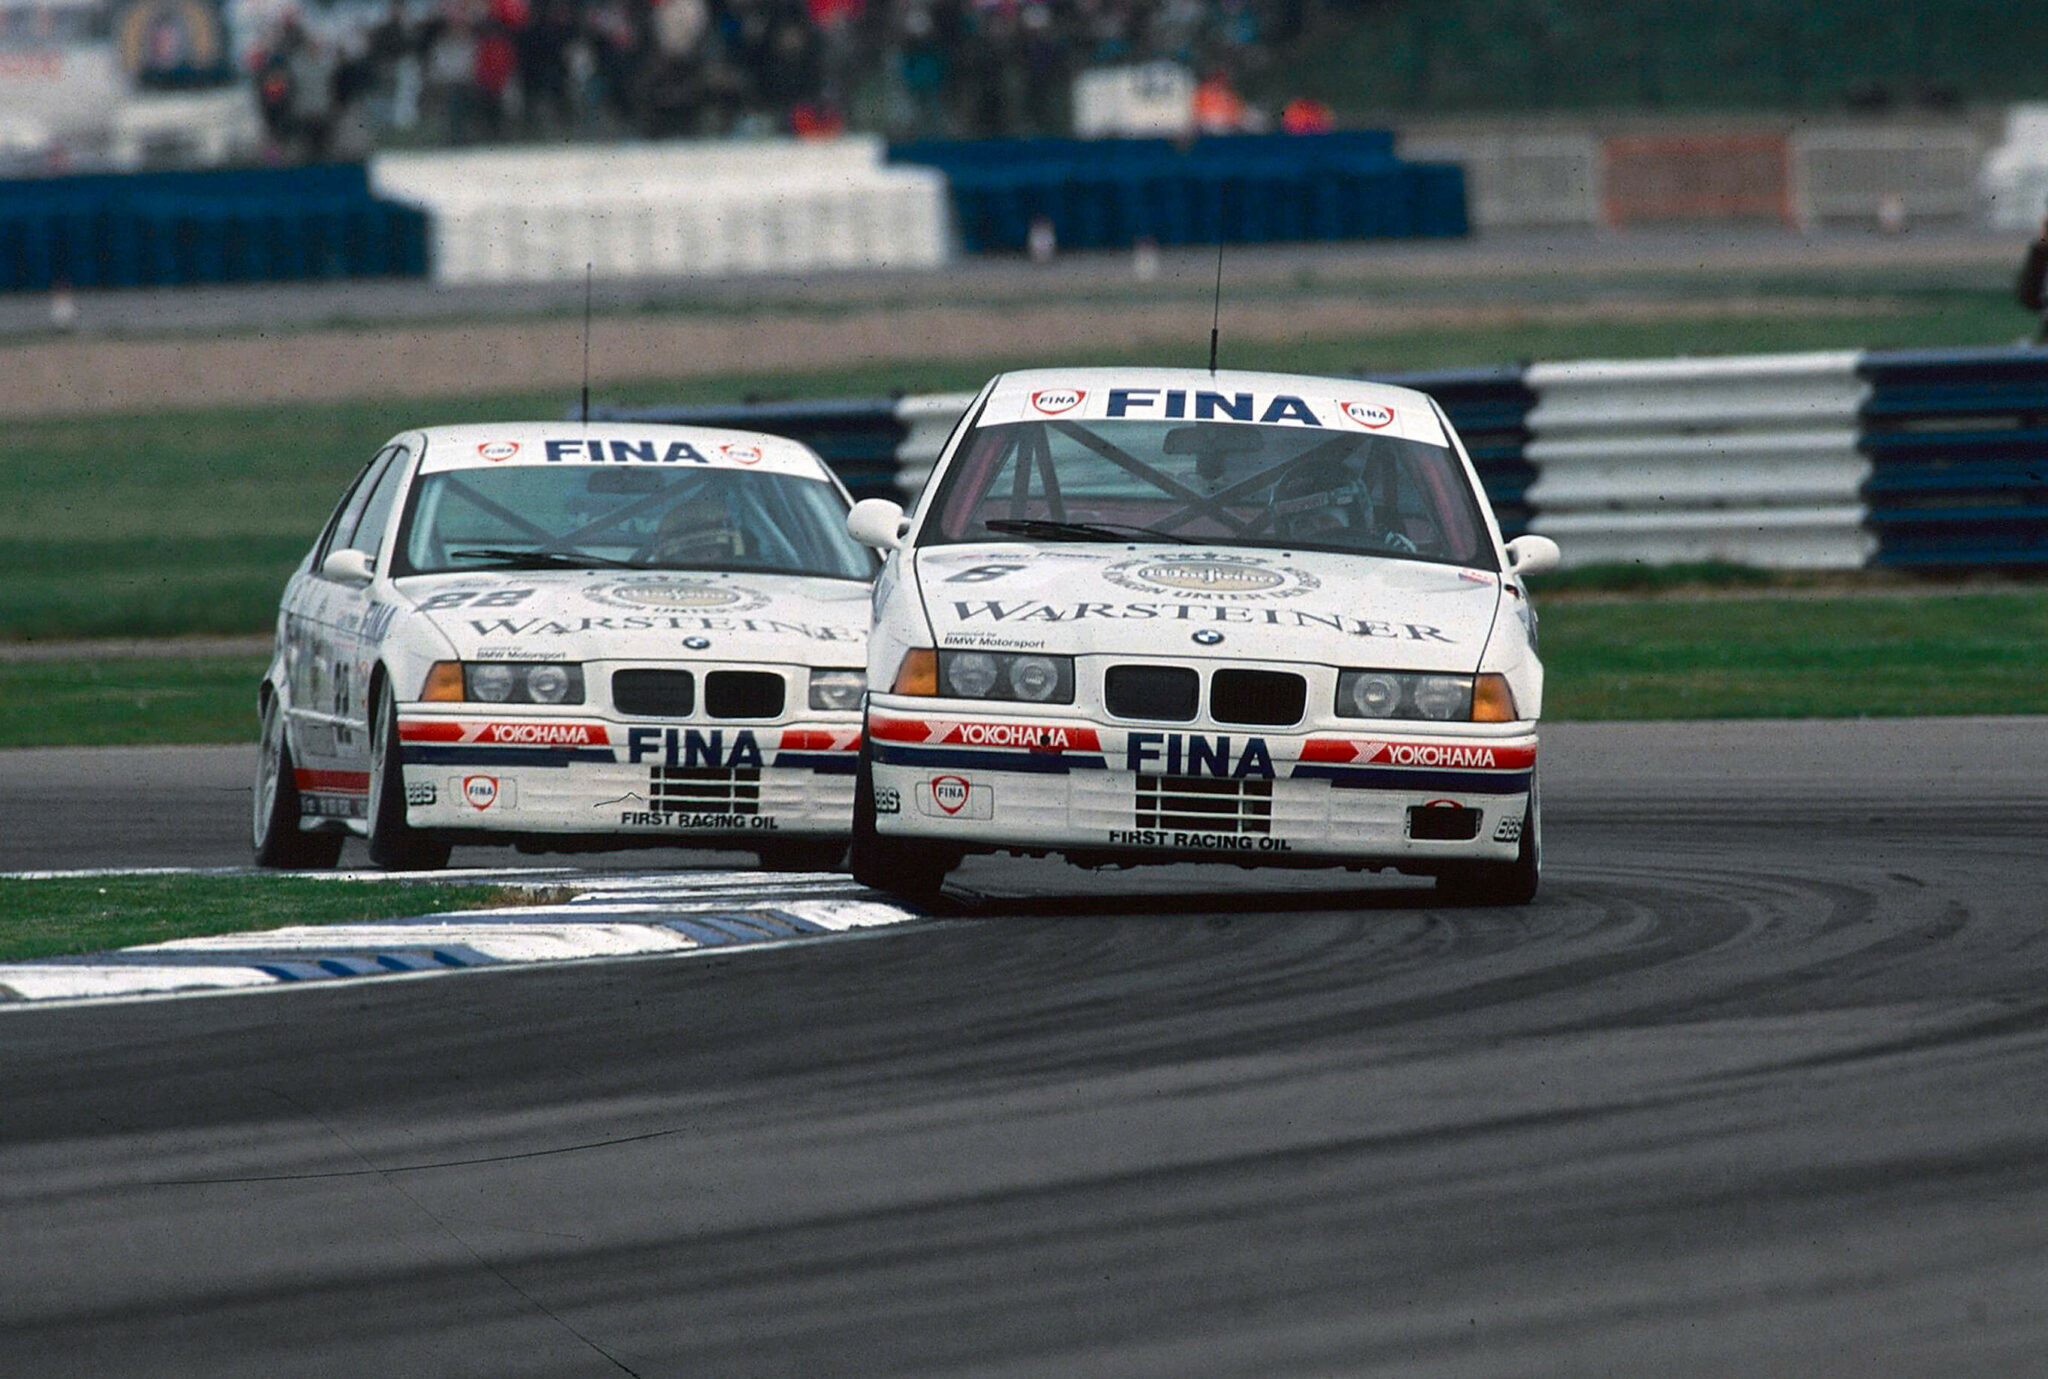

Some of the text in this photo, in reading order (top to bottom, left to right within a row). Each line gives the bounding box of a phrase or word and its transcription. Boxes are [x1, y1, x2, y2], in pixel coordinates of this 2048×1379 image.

[1038, 394, 1076, 405] FINA
[1106, 388, 1323, 426] FINA
[1350, 406, 1387, 420] FINA
[545, 439, 709, 464] FINA
[943, 564, 1028, 583] 6
[467, 617, 868, 643] WARSTEINE
[951, 599, 1459, 644] WARSTEINER
[945, 636, 1045, 650] BMW Motorsport
[490, 725, 590, 744] YOKOHAMA
[958, 724, 1070, 748] YOKOHAMA
[629, 728, 765, 767] FINA
[1127, 732, 1276, 780] FINA
[1387, 745, 1496, 768] YOKOHAMA
[469, 785, 494, 797] FINA
[938, 785, 965, 799] FINA
[621, 812, 779, 830] FIRST RACING OIL
[1109, 831, 1292, 851] FIRST RACING OIL
